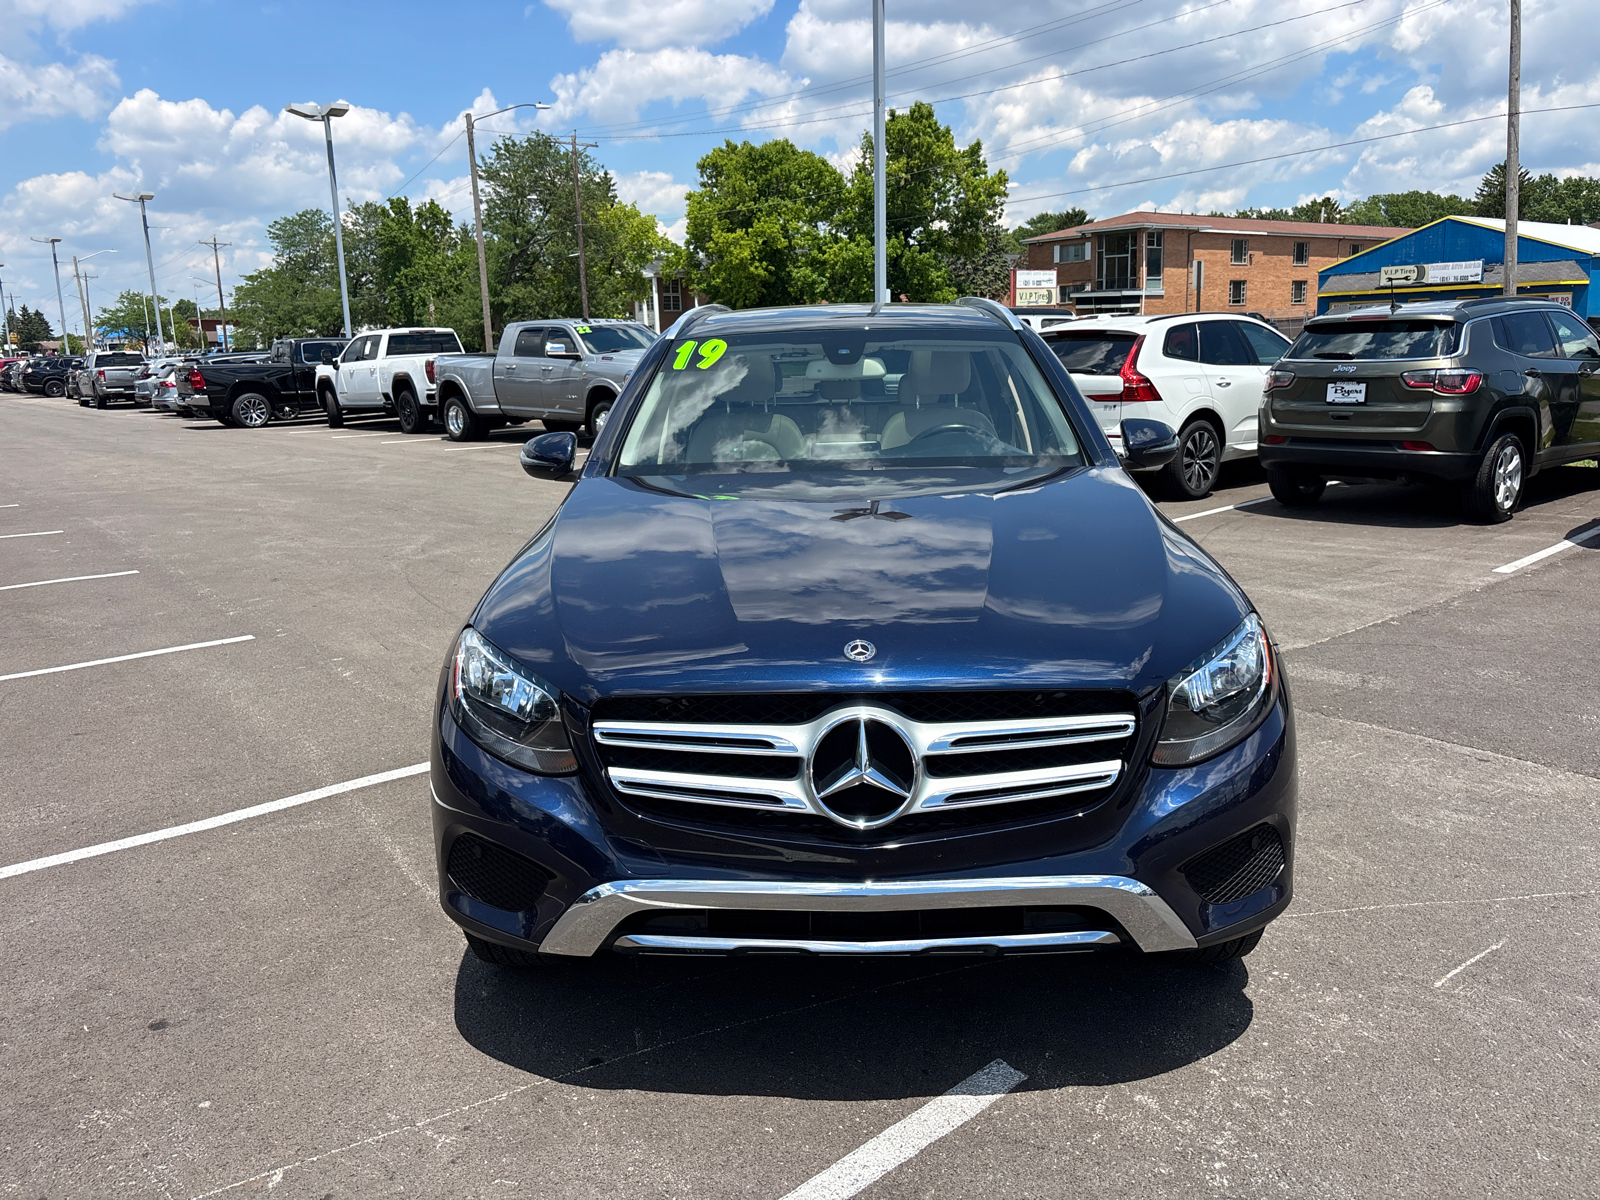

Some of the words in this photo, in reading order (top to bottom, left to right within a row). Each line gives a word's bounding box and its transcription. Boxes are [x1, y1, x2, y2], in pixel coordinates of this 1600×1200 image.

[1034, 292, 1048, 300] Tires
[576, 326, 592, 334] 22
[672, 338, 728, 370] 19
[1332, 364, 1357, 374] Jeep
[1330, 385, 1363, 397] Byers
